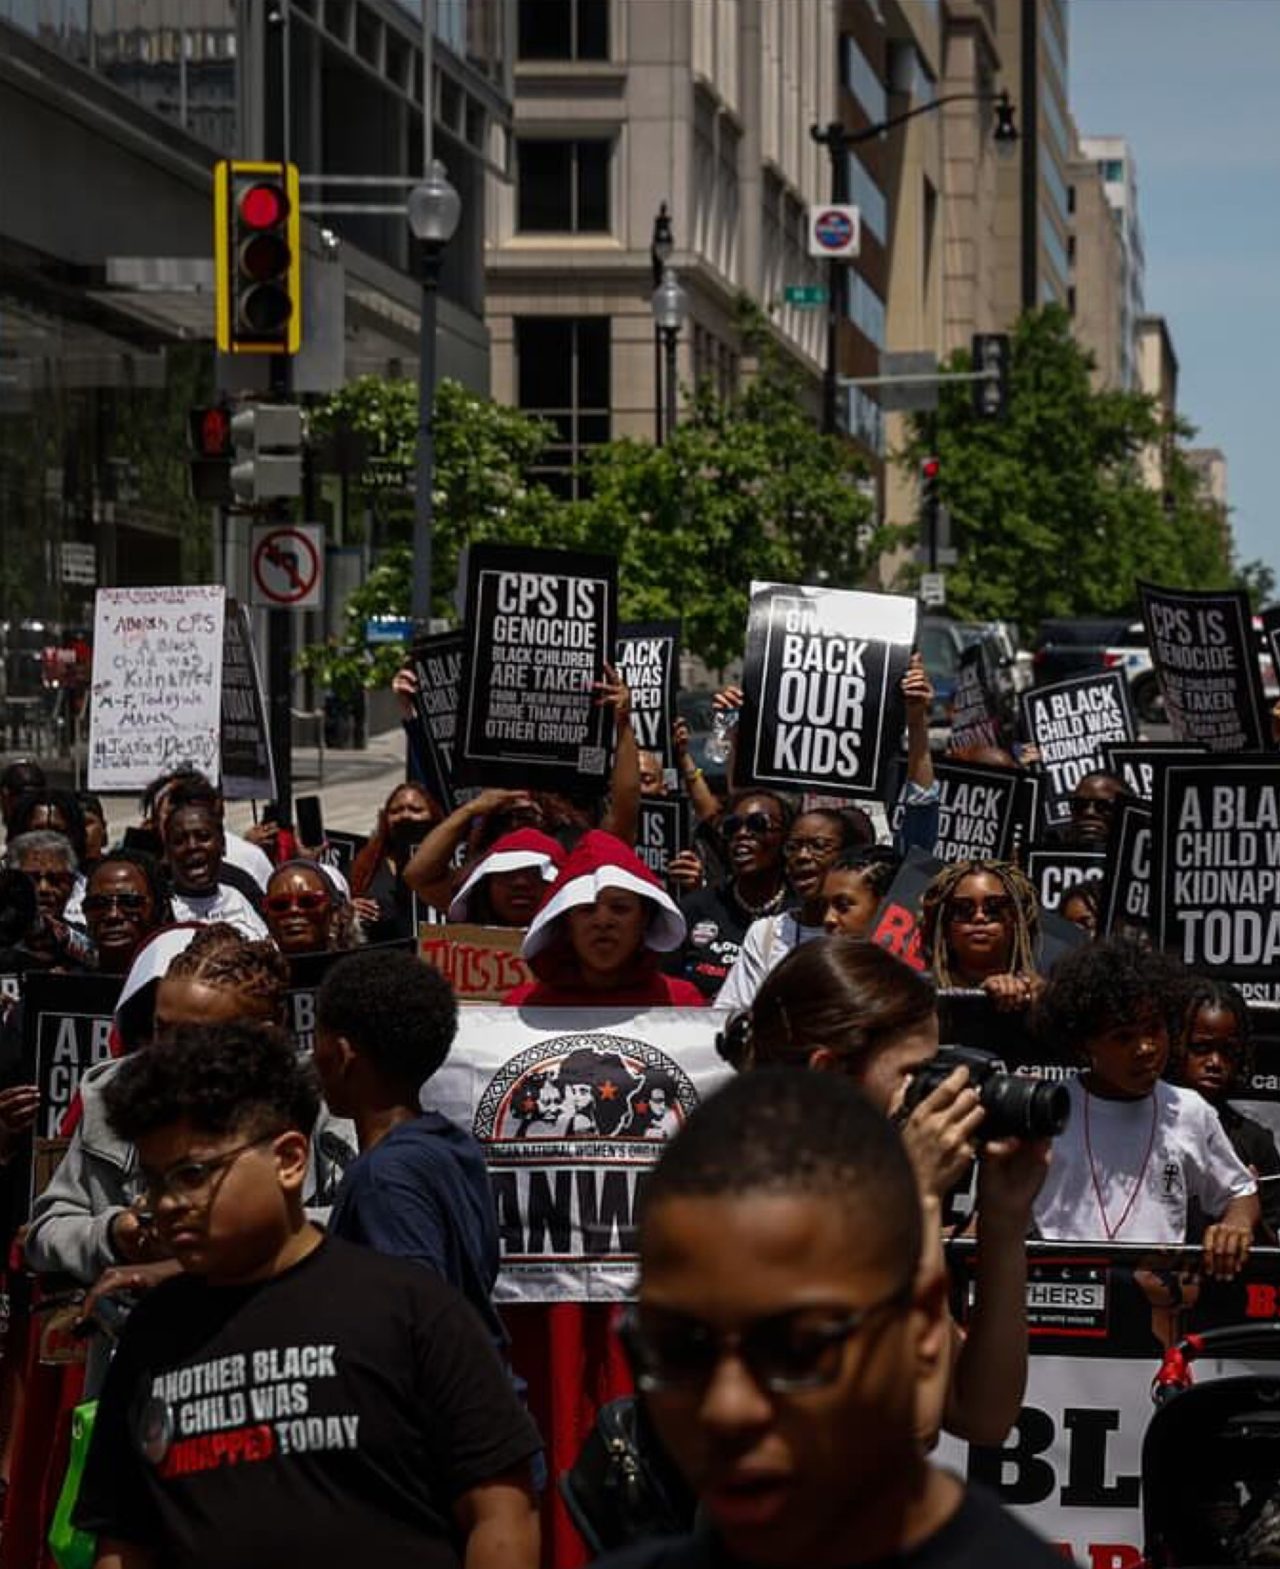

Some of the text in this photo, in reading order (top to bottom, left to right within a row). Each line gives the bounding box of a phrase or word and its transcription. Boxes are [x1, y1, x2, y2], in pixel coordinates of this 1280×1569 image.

[497, 573, 595, 619] CPS IS
[492, 616, 597, 649] GENOCIDE
[1151, 602, 1226, 646] CPS IS
[613, 640, 665, 667] ACK
[782, 635, 869, 677] BACK
[489, 664, 595, 692] ARE TAKEN
[624, 666, 663, 687] WAS
[778, 670, 866, 730] OUR
[1034, 685, 1117, 725] A BLACK
[484, 720, 590, 744] OTHER GROUP
[1036, 709, 1123, 743] CHILD WAS
[773, 724, 861, 778] KIDS
[939, 779, 1004, 820] LACK
[1178, 787, 1206, 830] A
[642, 811, 666, 846] IS
[954, 815, 999, 847] WAS
[1175, 831, 1258, 868] CHILD
[53, 1017, 80, 1064] A
[151, 1345, 338, 1402] ANOTHER BLACK
[179, 1381, 309, 1436] CHILD WAS
[275, 1414, 360, 1455] TODAY
